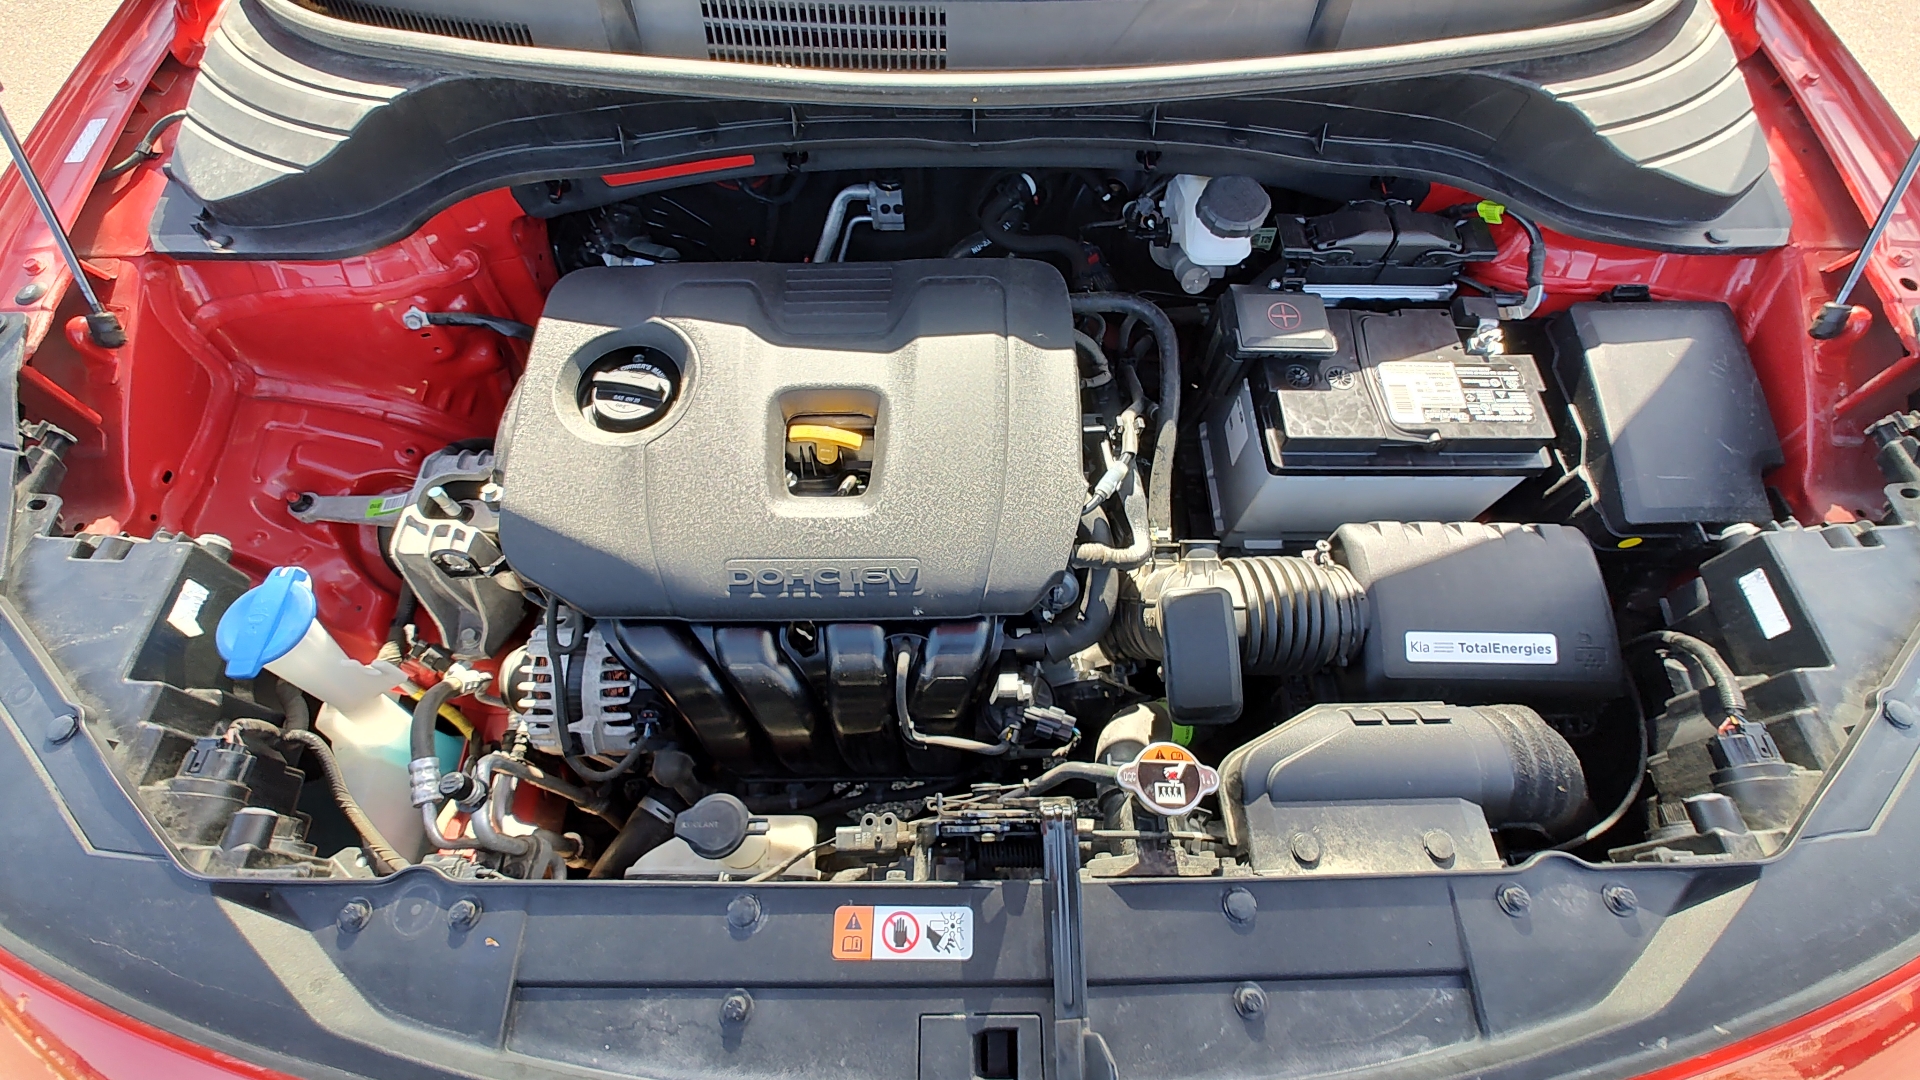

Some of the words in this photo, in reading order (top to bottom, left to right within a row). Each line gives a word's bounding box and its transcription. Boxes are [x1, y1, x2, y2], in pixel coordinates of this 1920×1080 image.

[727, 566, 841, 589] DOHC
[850, 566, 919, 589] 16V
[1410, 641, 1430, 653] Kia
[1458, 642, 1552, 656] TotalEnergies
